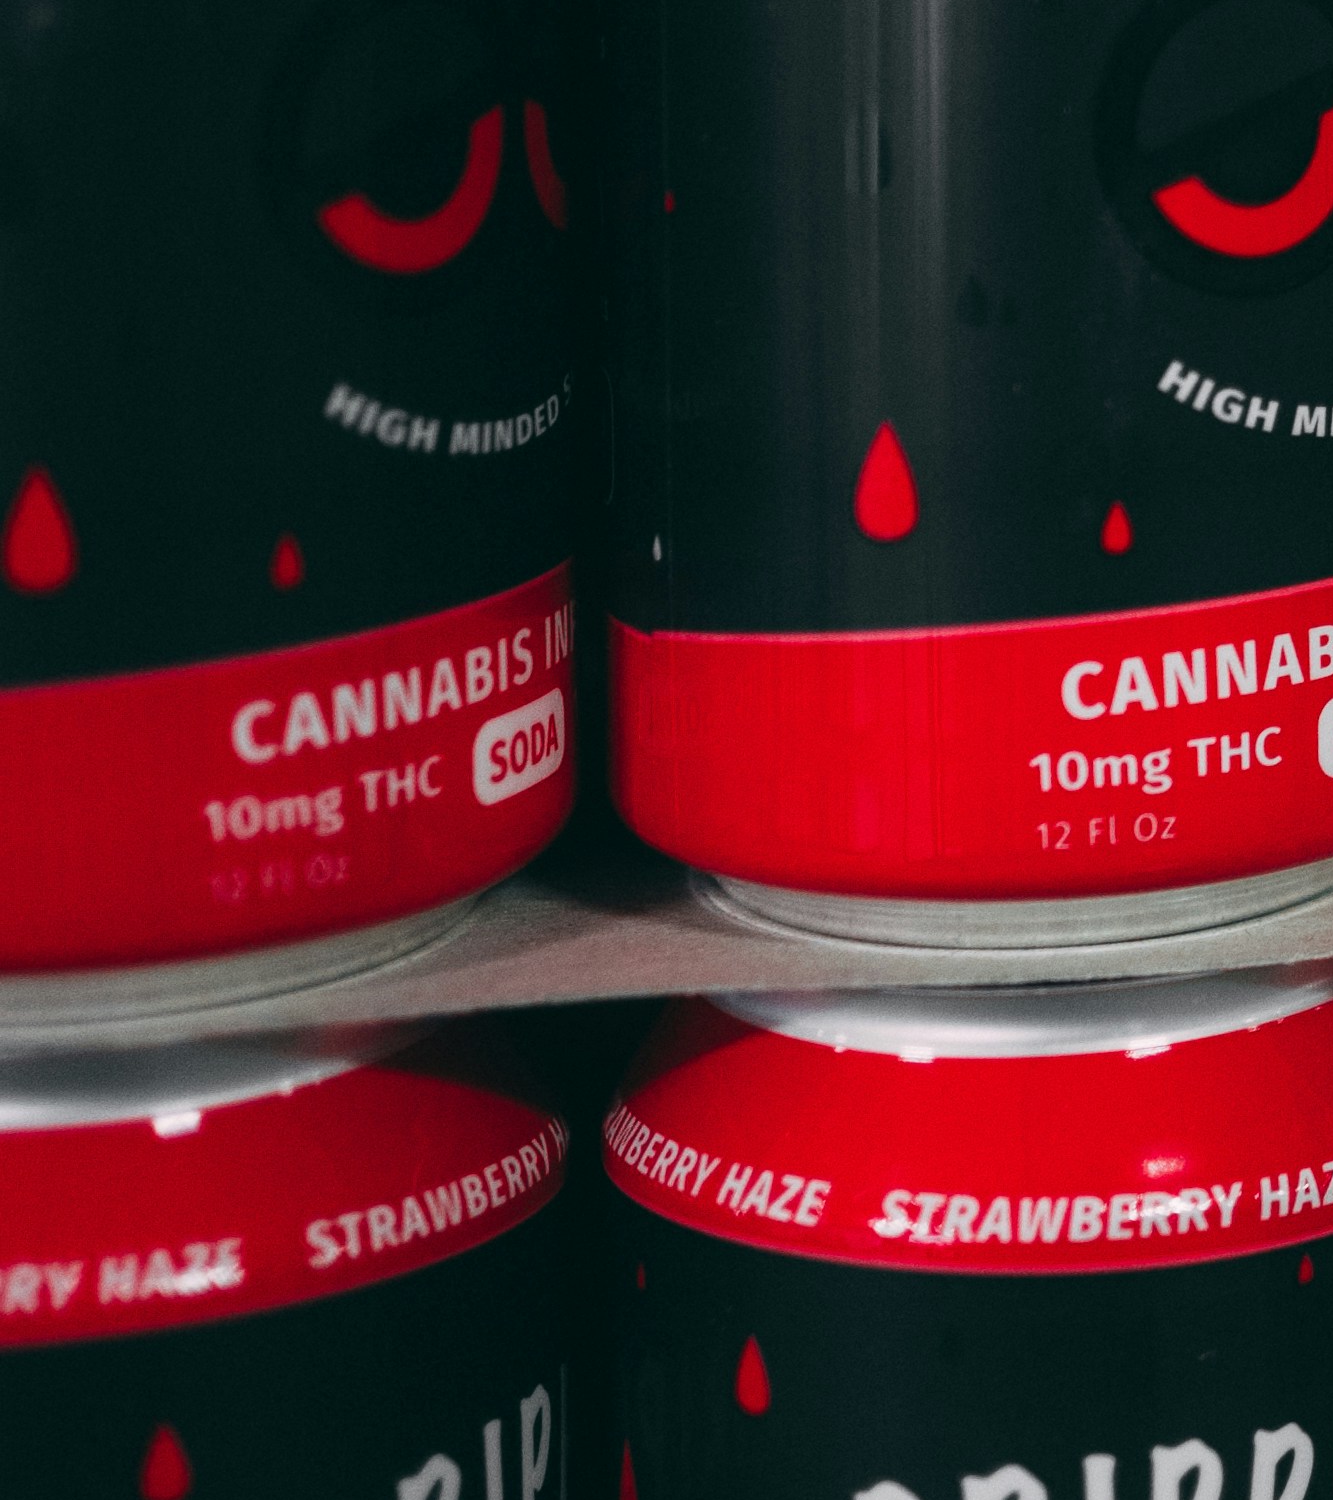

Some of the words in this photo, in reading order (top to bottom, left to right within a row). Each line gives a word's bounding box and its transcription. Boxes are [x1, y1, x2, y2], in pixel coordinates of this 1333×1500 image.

[324, 383, 439, 455] HIGH
[448, 393, 560, 455] MINDED
[1158, 359, 1279, 434] HIGH
[230, 627, 535, 766] CANNABIS
[202, 784, 346, 842] 10mg
[357, 752, 445, 814] THC
[486, 709, 561, 784] SODA
[1027, 748, 1173, 795] 10mg
[1187, 727, 1284, 779] THC
[1037, 820, 1072, 852] 12
[1134, 812, 1177, 844] Oz
[305, 1130, 551, 1271] STRAWBERRY
[715, 1162, 831, 1229] HAZE
[873, 1180, 1244, 1245] STRAWBERRY
